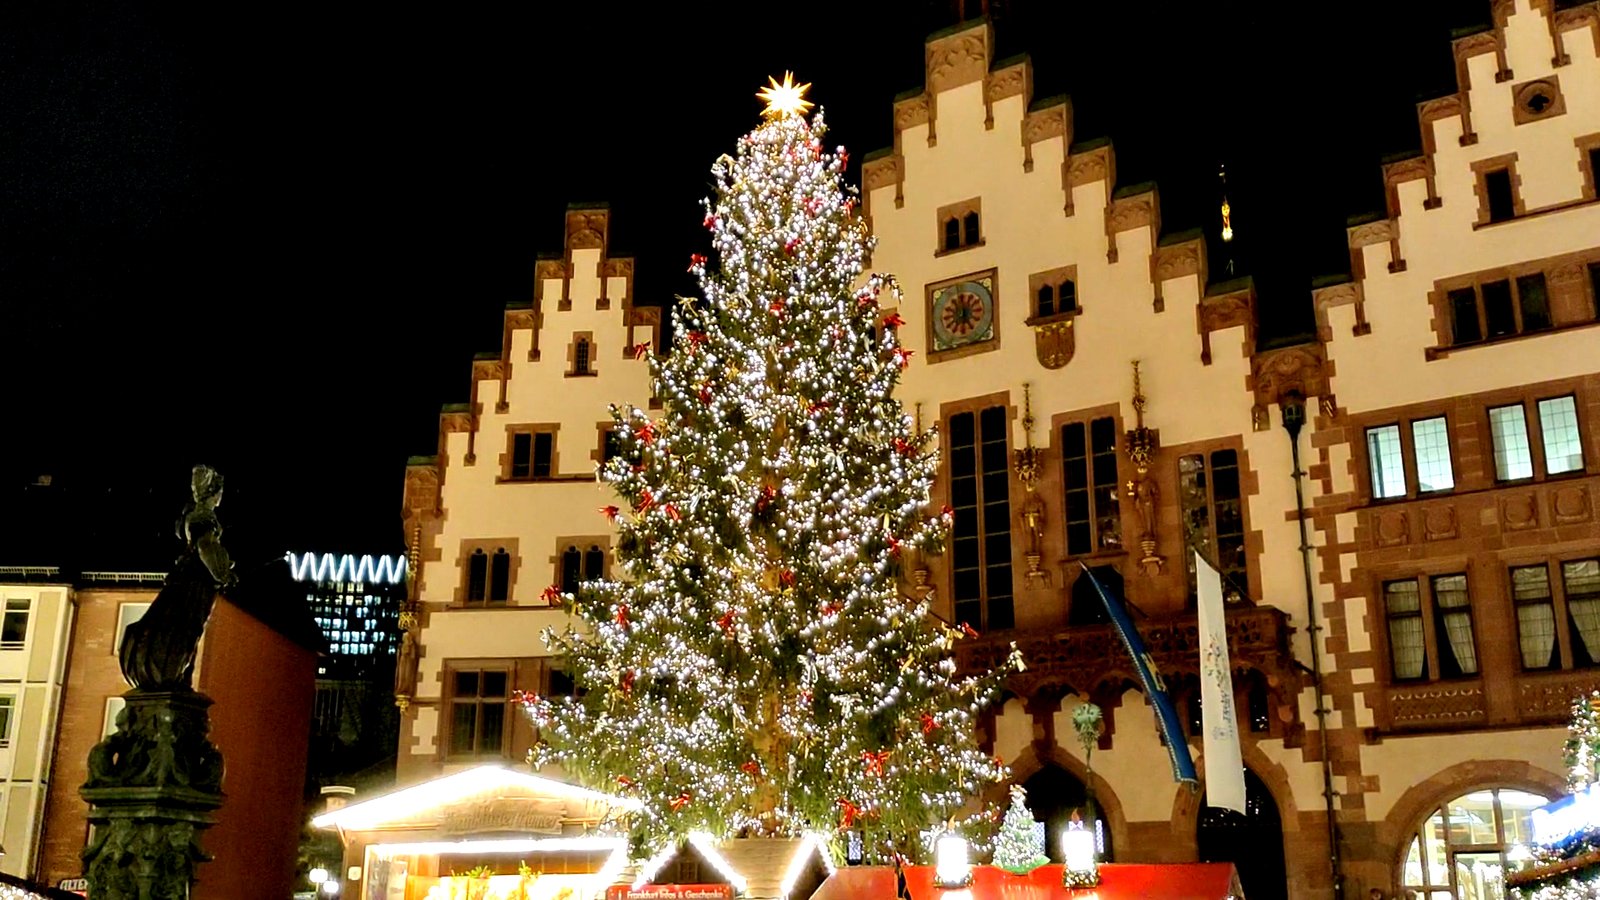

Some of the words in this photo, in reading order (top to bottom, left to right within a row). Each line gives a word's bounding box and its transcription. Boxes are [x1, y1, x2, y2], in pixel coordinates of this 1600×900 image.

[626, 889, 658, 899] Frankfurt
[660, 888, 676, 899] Infos
[677, 891, 683, 899] &
[685, 889, 723, 899] Geschenke
